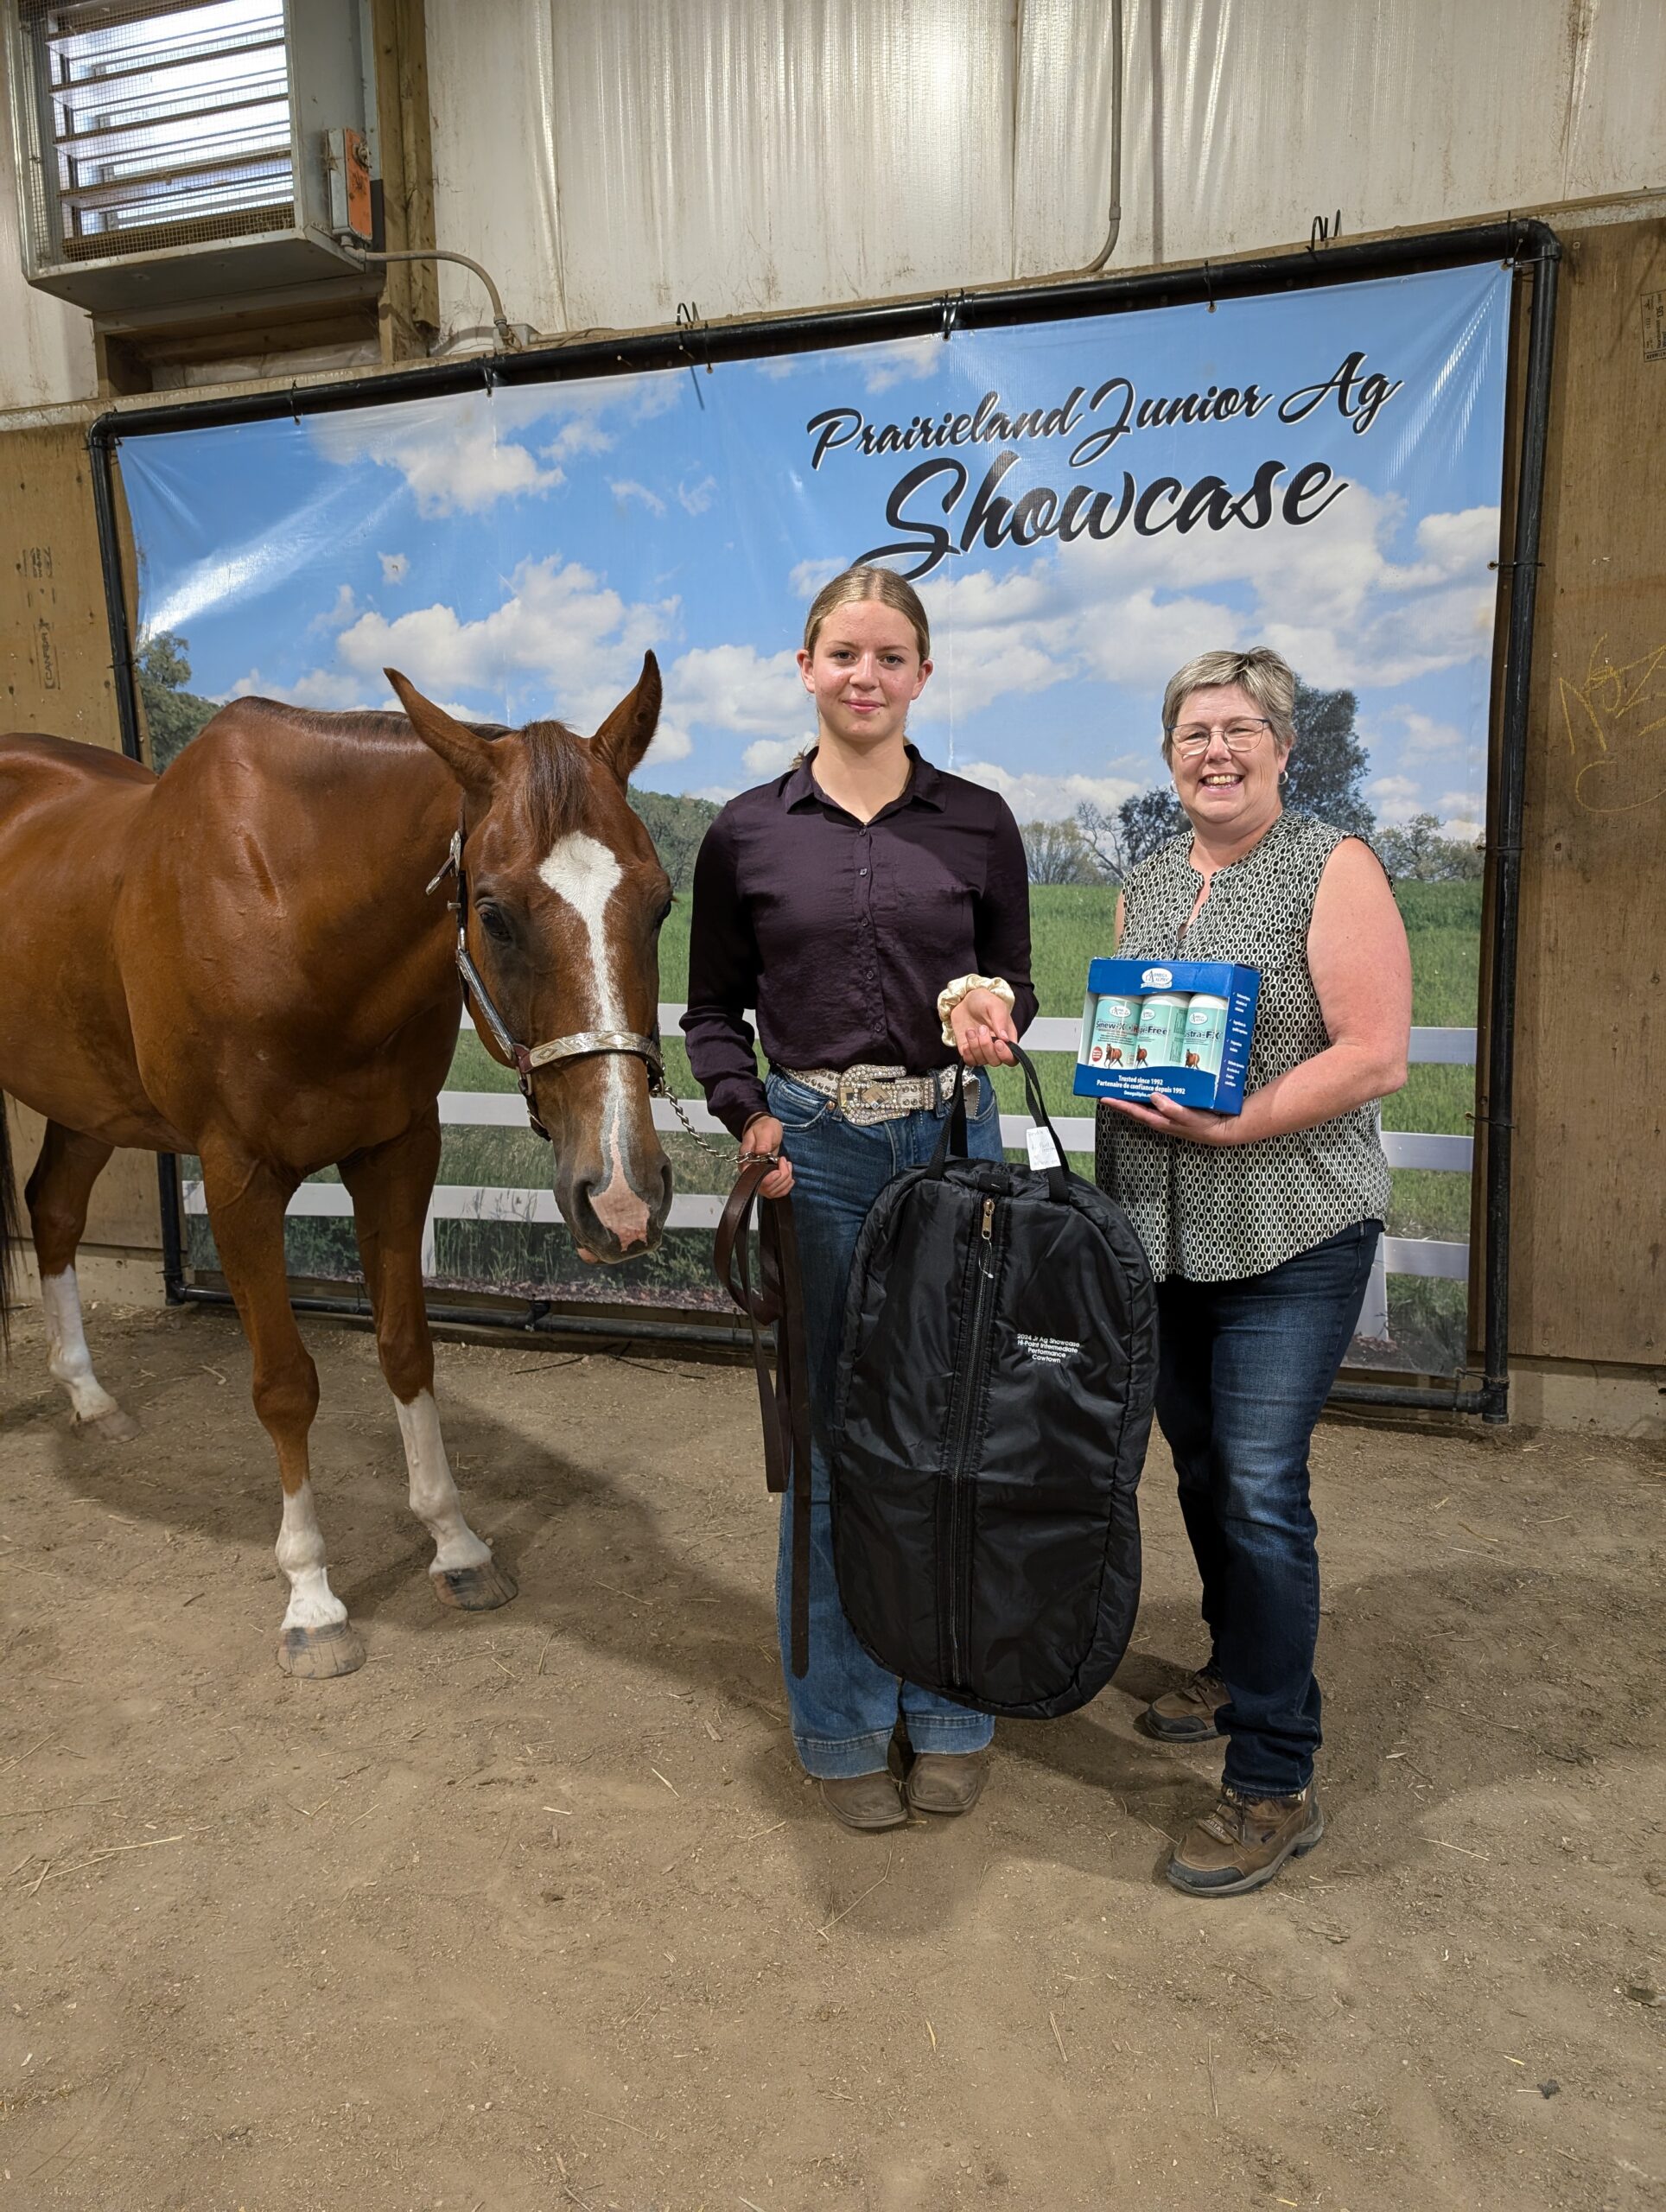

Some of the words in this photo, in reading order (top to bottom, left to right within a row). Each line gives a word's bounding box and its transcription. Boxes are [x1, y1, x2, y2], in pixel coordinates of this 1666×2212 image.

[807, 387, 1086, 471] Prairieland
[1069, 378, 1274, 467] Junior
[1279, 351, 1405, 435] Ag
[849, 450, 1350, 582] Showcase
[1097, 1079, 1122, 1089] Partenaire
[1049, 1338, 1080, 1347] Showcase
[1027, 1347, 1066, 1358] Performance
[1040, 1343, 1078, 1353] Intermediate
[1032, 1354, 1061, 1363] Cowtown
